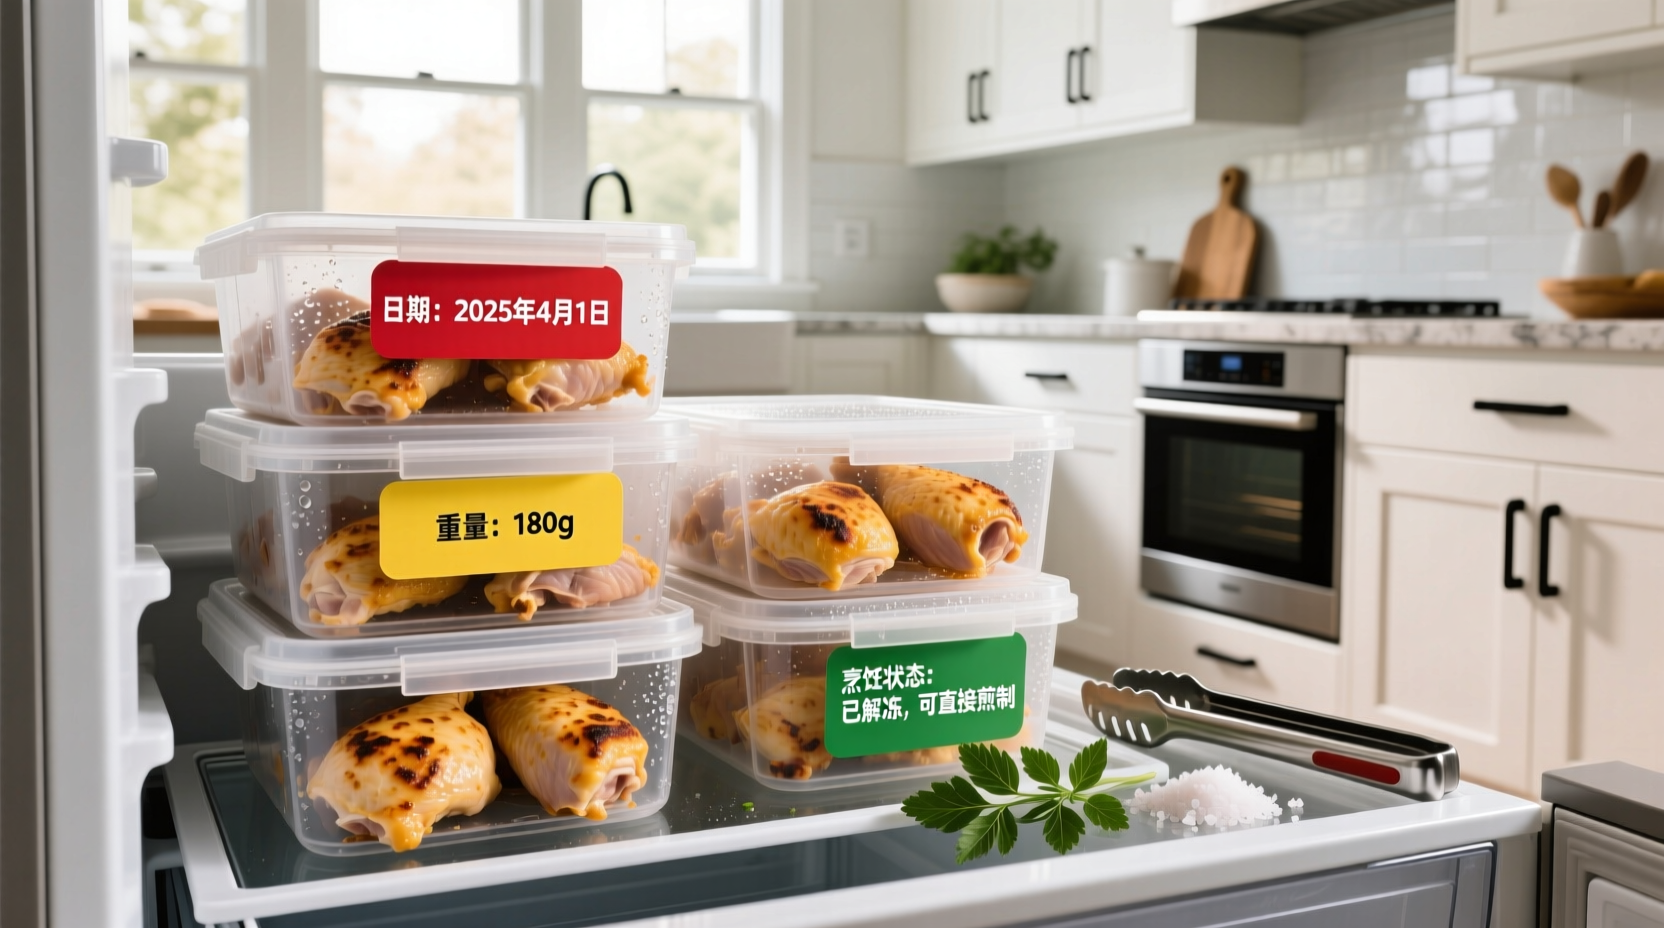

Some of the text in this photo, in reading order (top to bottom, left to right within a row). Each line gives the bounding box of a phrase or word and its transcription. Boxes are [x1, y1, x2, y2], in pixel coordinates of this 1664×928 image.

[383, 294, 609, 326] 日期：2025年4月1日
[436, 511, 574, 542] 重量：180g
[842, 662, 933, 695] 烹饪状态：
[842, 684, 1016, 724] 已解冻，可直接煎制
